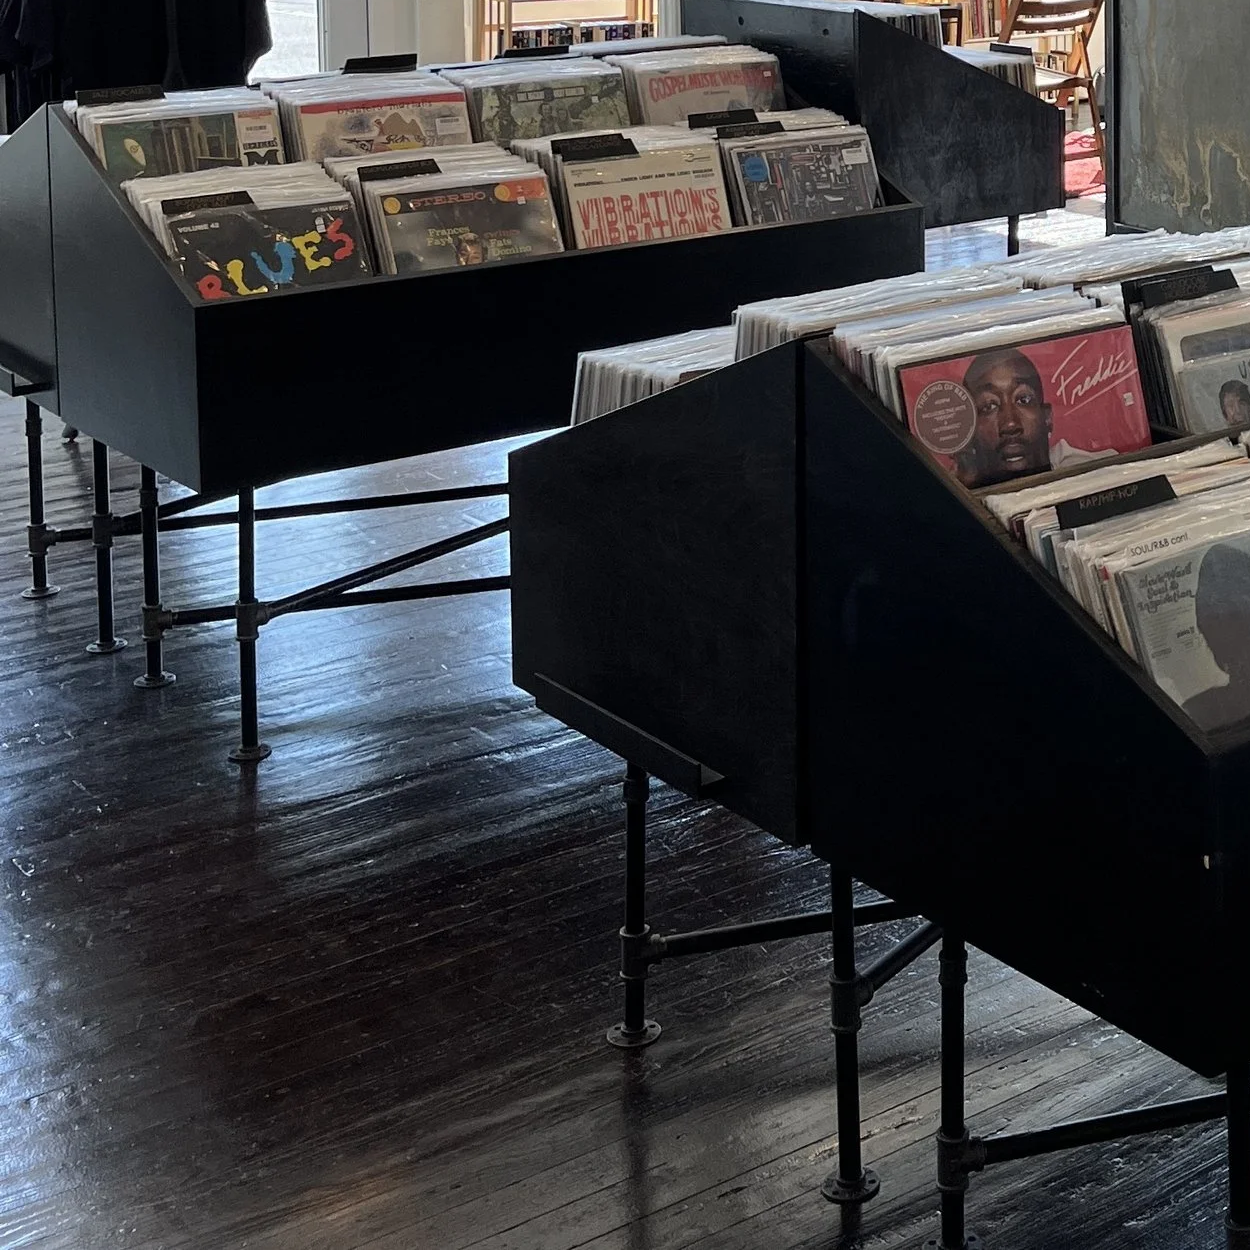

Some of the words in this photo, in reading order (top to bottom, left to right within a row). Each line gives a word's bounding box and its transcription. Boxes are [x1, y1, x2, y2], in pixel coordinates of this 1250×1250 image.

[410, 192, 487, 209] STEREO
[576, 187, 721, 231] VIBRATIONS
[178, 223, 209, 234] VOLUME
[427, 225, 470, 237] Frances
[493, 245, 533, 256] Domino
[1051, 340, 1133, 406] Freddie
[1079, 485, 1139, 510] RAP/HIP-HOP
[1129, 538, 1170, 557] SOUL/R&B
[1171, 532, 1191, 545] cont.
